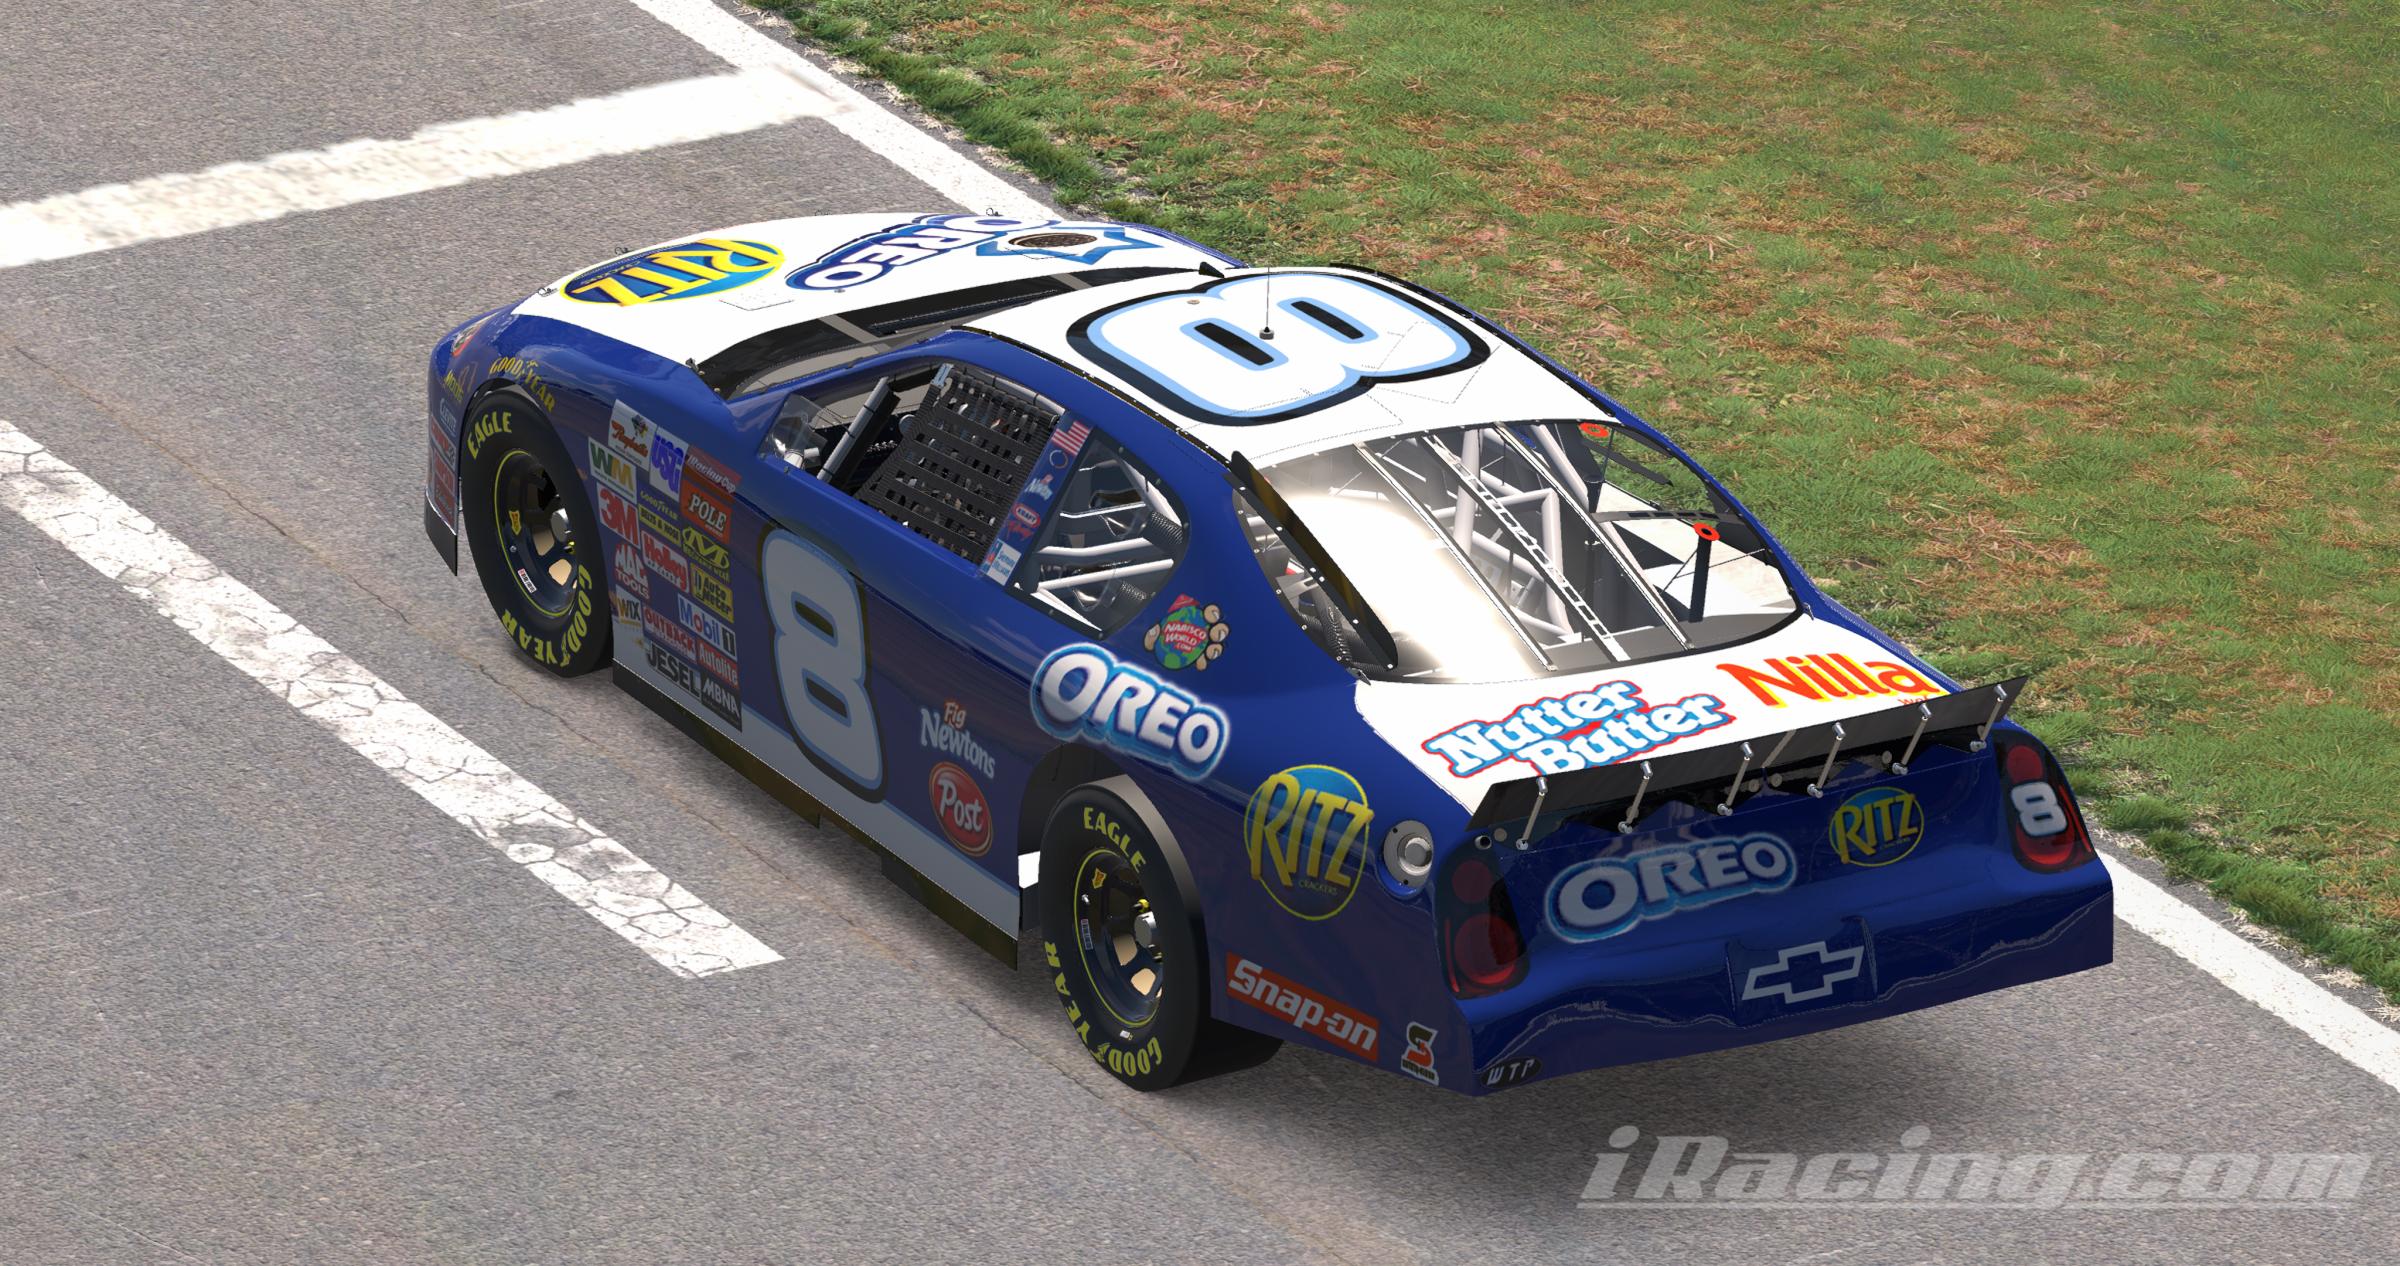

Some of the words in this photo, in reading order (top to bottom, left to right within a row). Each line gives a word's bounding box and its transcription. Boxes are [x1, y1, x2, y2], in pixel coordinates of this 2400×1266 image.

[571, 238, 784, 306] RITZ
[795, 214, 1054, 289] OREO
[1070, 272, 1488, 425] 8
[489, 356, 556, 412] GOODYEAR
[467, 411, 512, 460] EAGLE
[600, 488, 638, 546] 3M
[689, 494, 727, 532] POLE
[615, 568, 650, 600] TOOLS
[619, 599, 640, 621] WIX
[502, 564, 593, 668] GOODYEAR
[679, 599, 721, 647] Mobil
[1165, 622, 1207, 641] NABISCO
[1165, 632, 1198, 646] WORLD
[647, 644, 701, 698] JESEL
[699, 644, 738, 686] Autolite
[760, 525, 886, 800] 8
[1717, 654, 1941, 709] Nilla
[703, 678, 740, 716] MBNA
[944, 702, 966, 728] Fig
[1036, 648, 1225, 772] OREO
[920, 708, 996, 779] Newtons
[1424, 680, 1646, 777] Nutter
[1522, 694, 1735, 778] Butter
[938, 778, 983, 832] Post
[1250, 773, 1375, 888] RITZ
[1833, 793, 1919, 865] RITZ
[2010, 781, 2068, 837] 8
[1083, 807, 1147, 873] EAGLE
[1551, 836, 1792, 936] OREO
[1044, 941, 1163, 1078] GOODYEAR
[1229, 958, 1378, 1052] Snap-on
[1487, 1058, 1536, 1086] WTP
